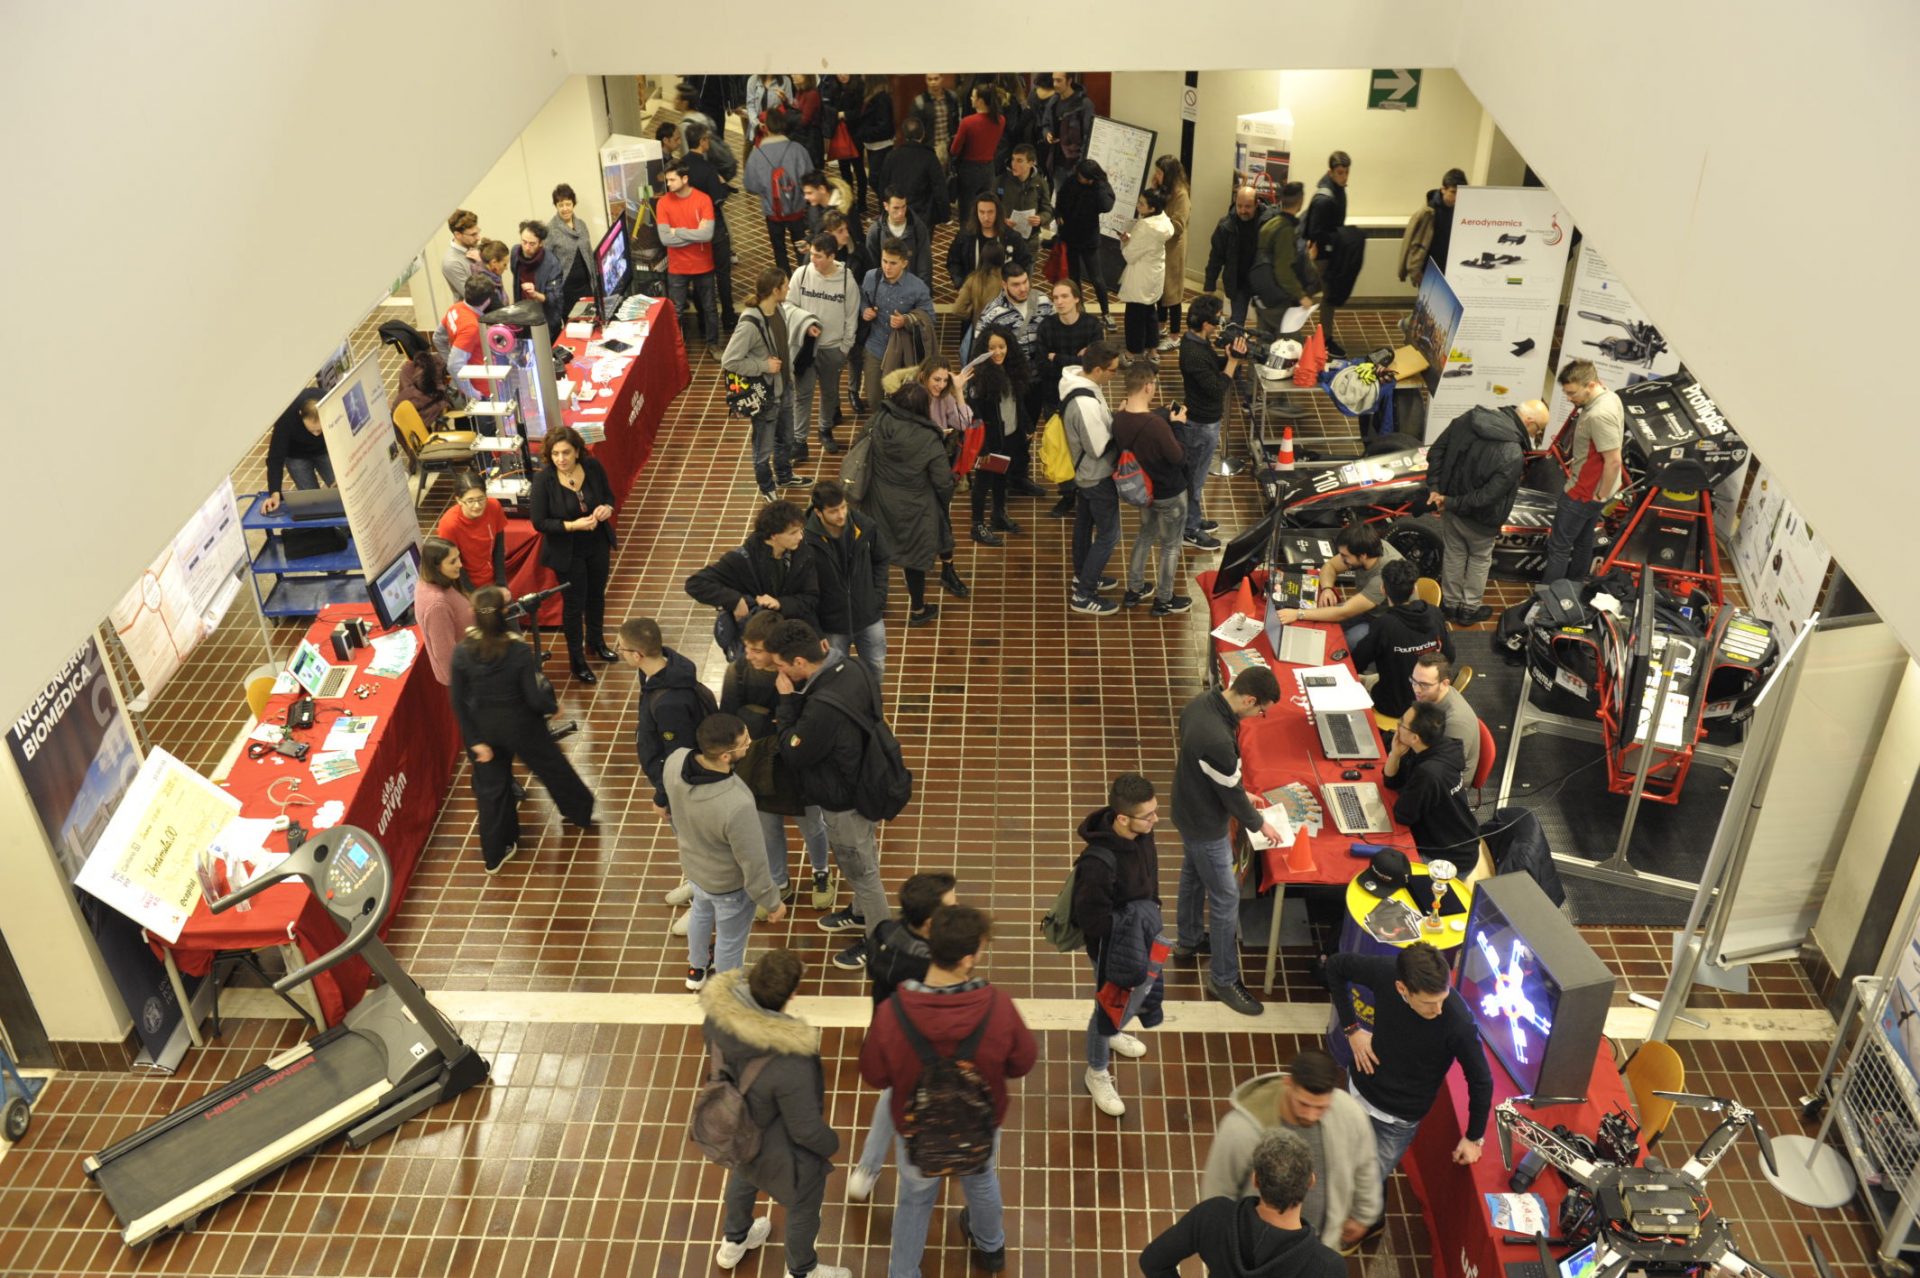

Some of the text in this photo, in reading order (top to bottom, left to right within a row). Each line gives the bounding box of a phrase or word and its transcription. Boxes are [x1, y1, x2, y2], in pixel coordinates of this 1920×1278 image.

[1460, 218, 1523, 227] Aerodynamics
[1312, 470, 1340, 493] 110
[22, 664, 92, 762] BIOMEDICA
[378, 772, 407, 836] univpm
[204, 1055, 316, 1120] HIGH POWER
